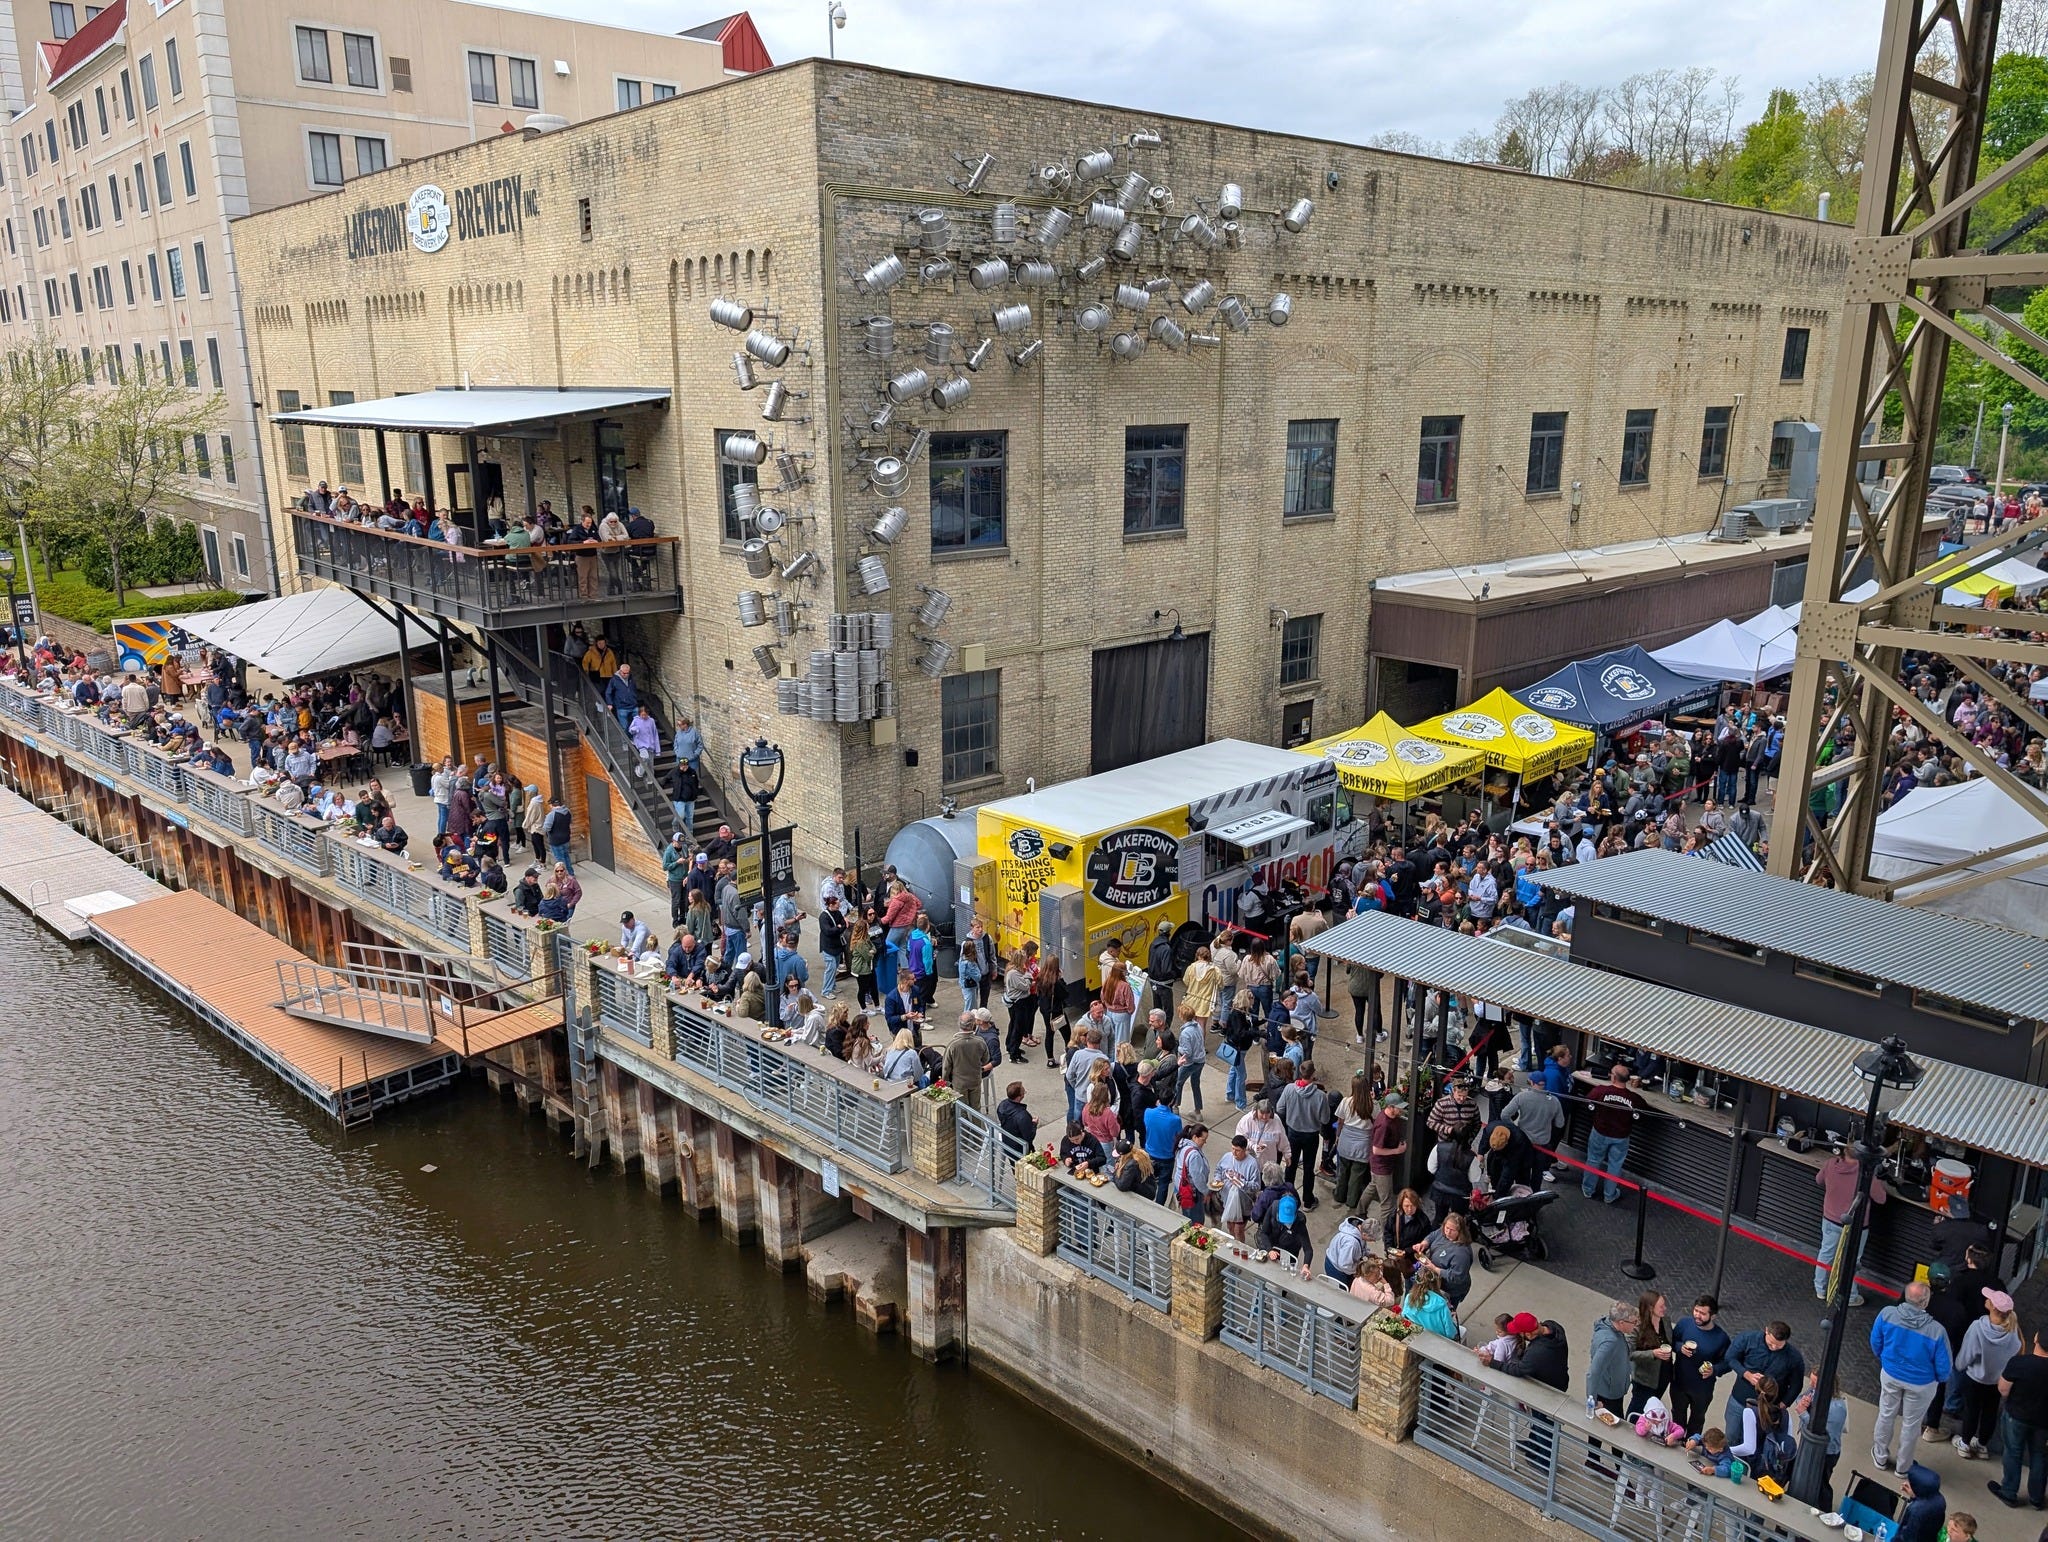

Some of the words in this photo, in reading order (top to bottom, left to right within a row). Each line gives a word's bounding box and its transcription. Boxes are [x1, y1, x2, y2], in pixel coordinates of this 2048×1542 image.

[411, 189, 442, 209] LAKEFRONT
[345, 202, 408, 259] LAKEFRONT
[455, 175, 523, 241] BREWERY
[523, 188, 541, 218] INC.
[1540, 689, 1573, 699] LAKEFRONT
[1456, 714, 1501, 728] LAKEFRONT
[1605, 709, 1642, 731] LAKEFRONT
[1642, 698, 1671, 718] BREWERY
[1339, 741, 1385, 752] LAKEFRONT
[1415, 766, 1449, 795] LAKEFRONT
[1450, 758, 1477, 780] BREWERY
[1529, 764, 1554, 780] CHEESE
[1343, 771, 1388, 795] BREWERY
[1106, 833, 1175, 856] LAKEFRONT
[771, 845, 791, 861] BEER
[771, 857, 792, 874] HALL
[1001, 860, 1013, 869] IT'S
[1093, 863, 1110, 871] MILW
[738, 871, 760, 885] BREWERY
[1001, 869, 1020, 879] FRIED
[1105, 886, 1159, 905] BREWERY
